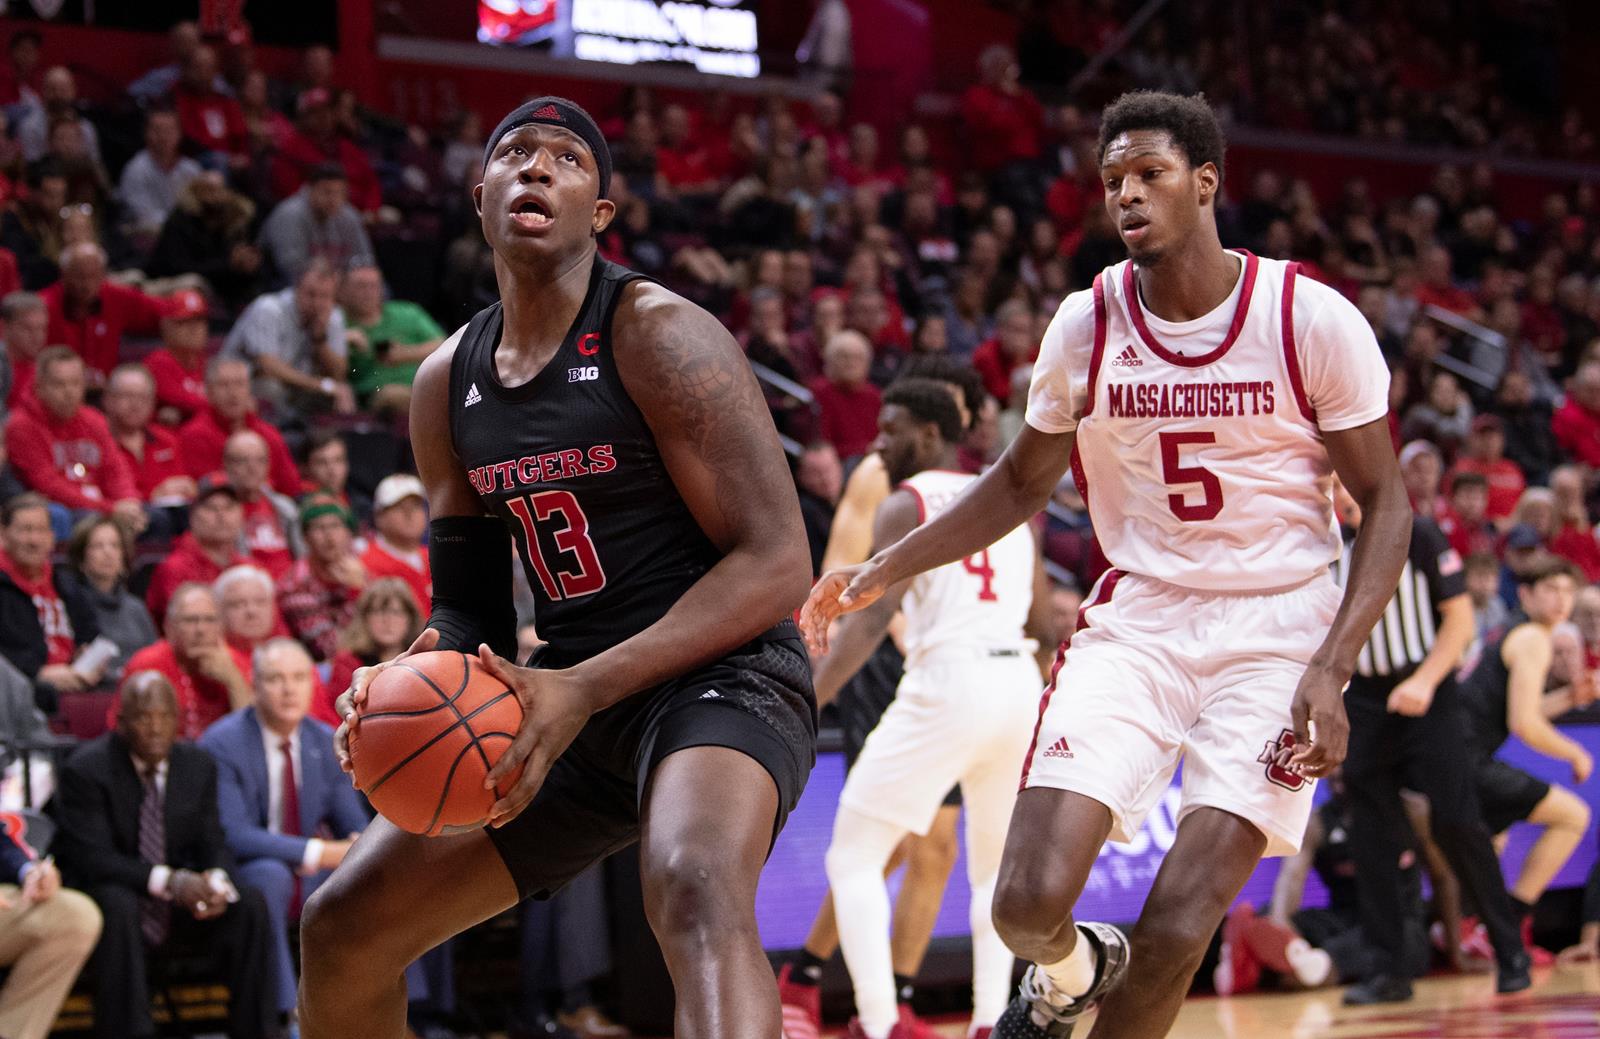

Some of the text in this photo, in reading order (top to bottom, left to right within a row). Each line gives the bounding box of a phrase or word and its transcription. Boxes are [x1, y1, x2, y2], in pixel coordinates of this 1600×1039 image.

[577, 332, 600, 356] C
[1112, 359, 1143, 367] adidas
[1108, 381, 1275, 418] MASSACHUSETTS
[468, 444, 617, 496] RUTGERS
[1159, 431, 1224, 522] 5
[505, 490, 606, 601] 13
[1043, 750, 1074, 759] adidas
